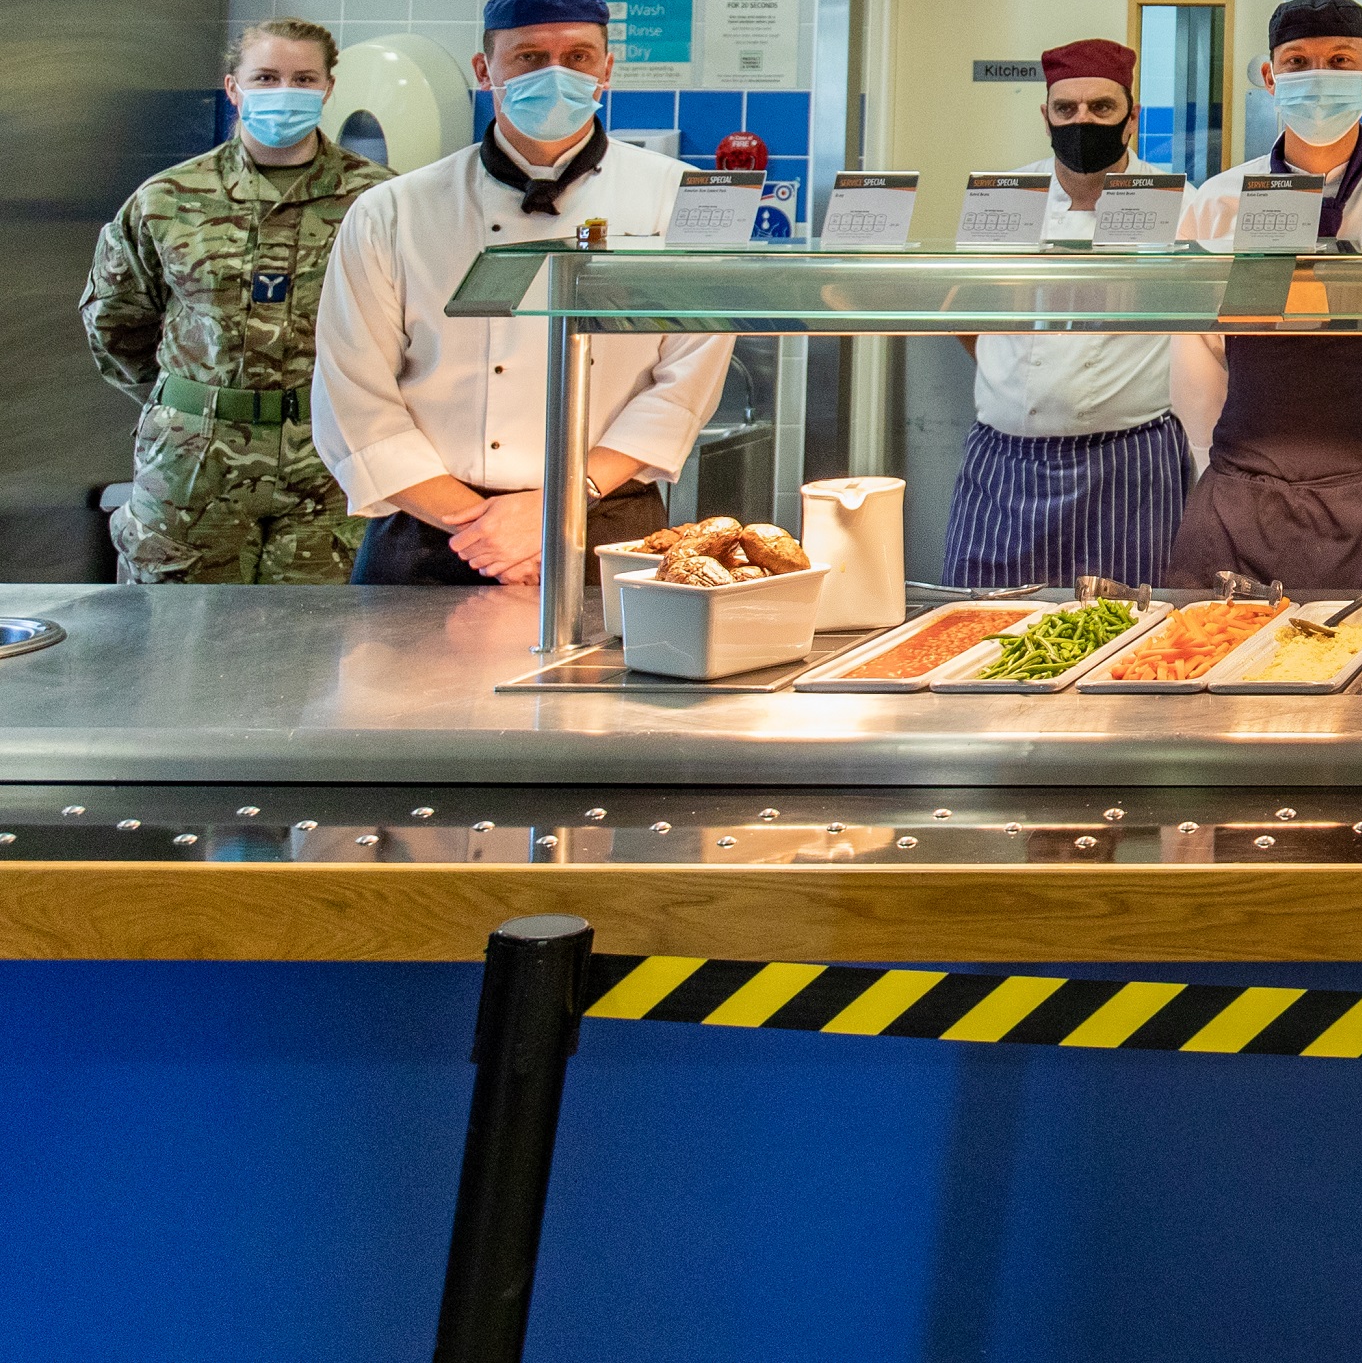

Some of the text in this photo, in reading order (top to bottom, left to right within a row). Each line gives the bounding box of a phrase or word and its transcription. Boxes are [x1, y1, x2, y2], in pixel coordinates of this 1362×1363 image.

[628, 4, 666, 16] Wash
[627, 24, 663, 37] Rinse
[627, 45, 653, 62] Dry
[985, 65, 1037, 77] Kitchen
[686, 175, 732, 185] SERVICE SPECIAL
[840, 178, 886, 187] SERVICE SPECIAL
[973, 178, 1019, 187] SERVICE SPECIAL
[1109, 178, 1154, 187] SERVICE SPECIAL
[1247, 180, 1293, 189] SERVICE SPECIAL
